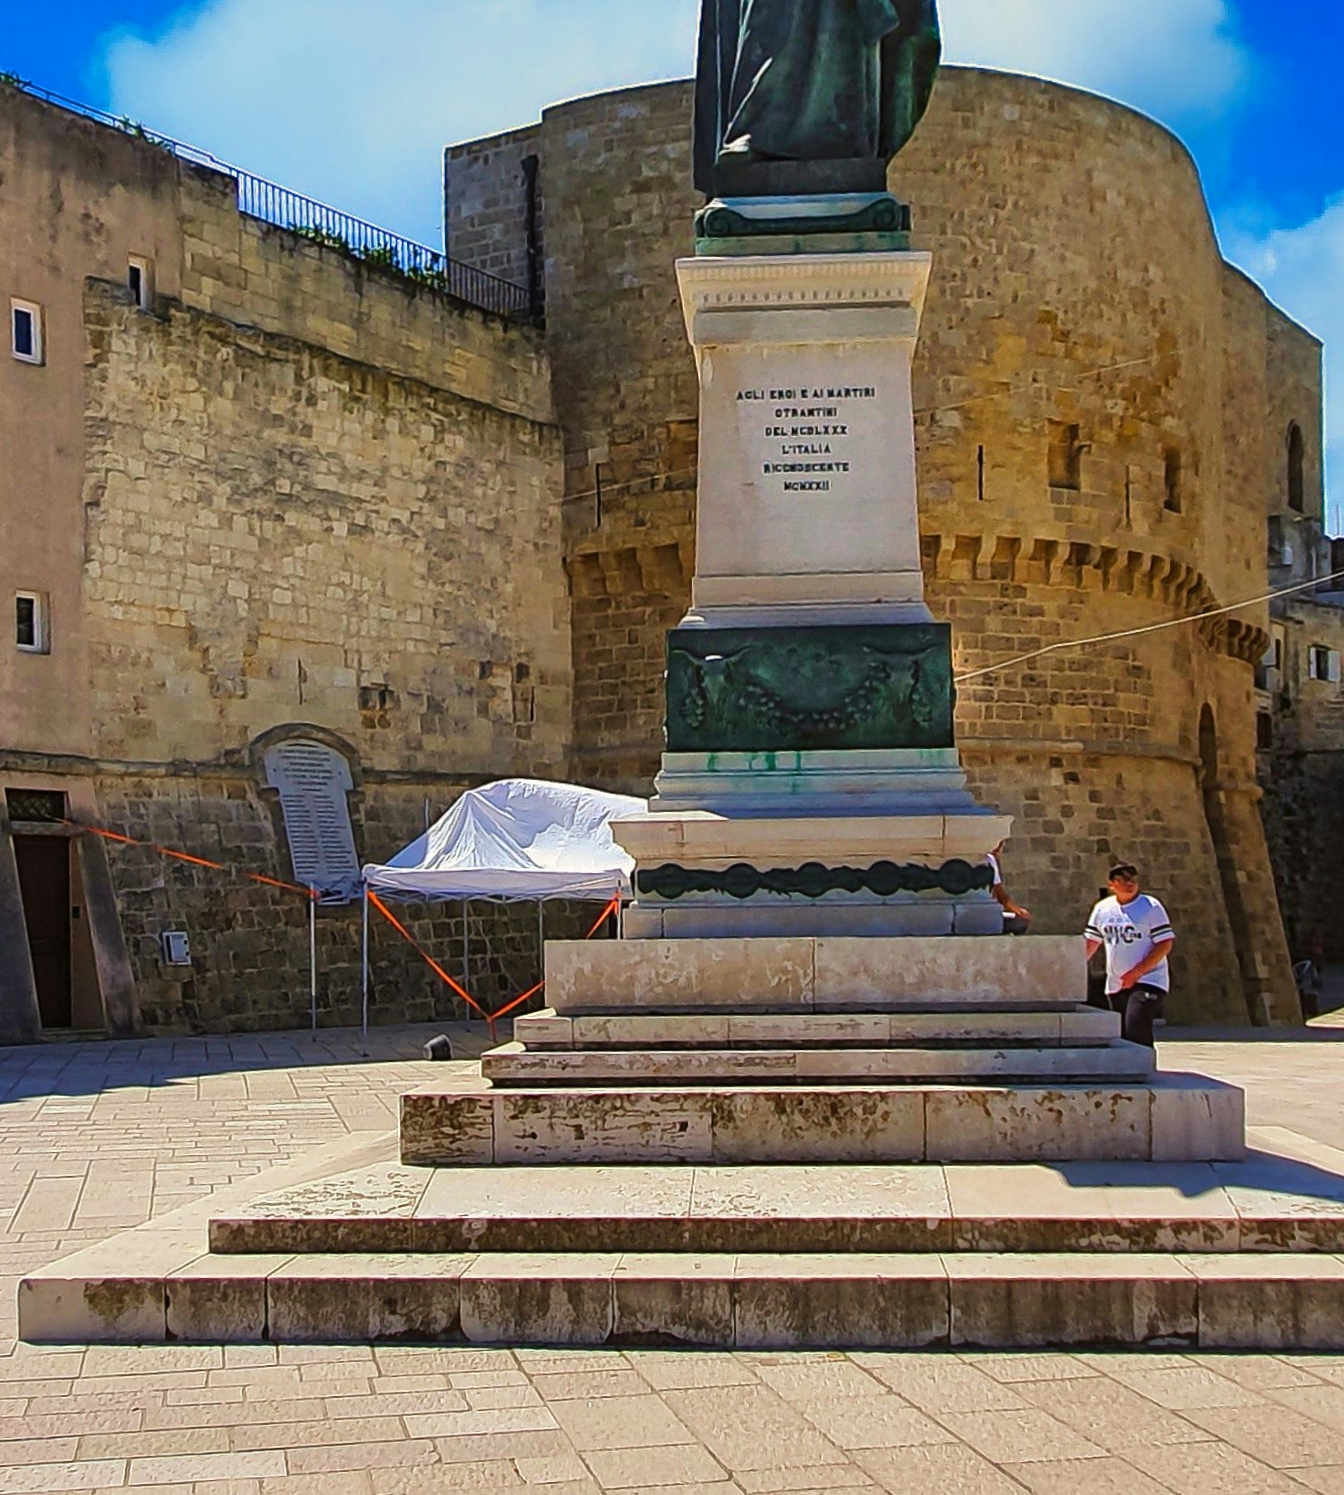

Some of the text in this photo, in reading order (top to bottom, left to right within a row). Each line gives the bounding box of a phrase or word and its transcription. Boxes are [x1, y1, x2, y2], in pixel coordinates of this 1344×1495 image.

[801, 389, 808, 398] E
[813, 389, 824, 398] AI
[828, 387, 875, 398] MARTIRI
[775, 407, 837, 418] OTRANTINI
[765, 425, 848, 437] DEL MCDLXXX
[782, 444, 831, 455] L'ITALIA
[763, 463, 849, 474] RICONOSCENTE
